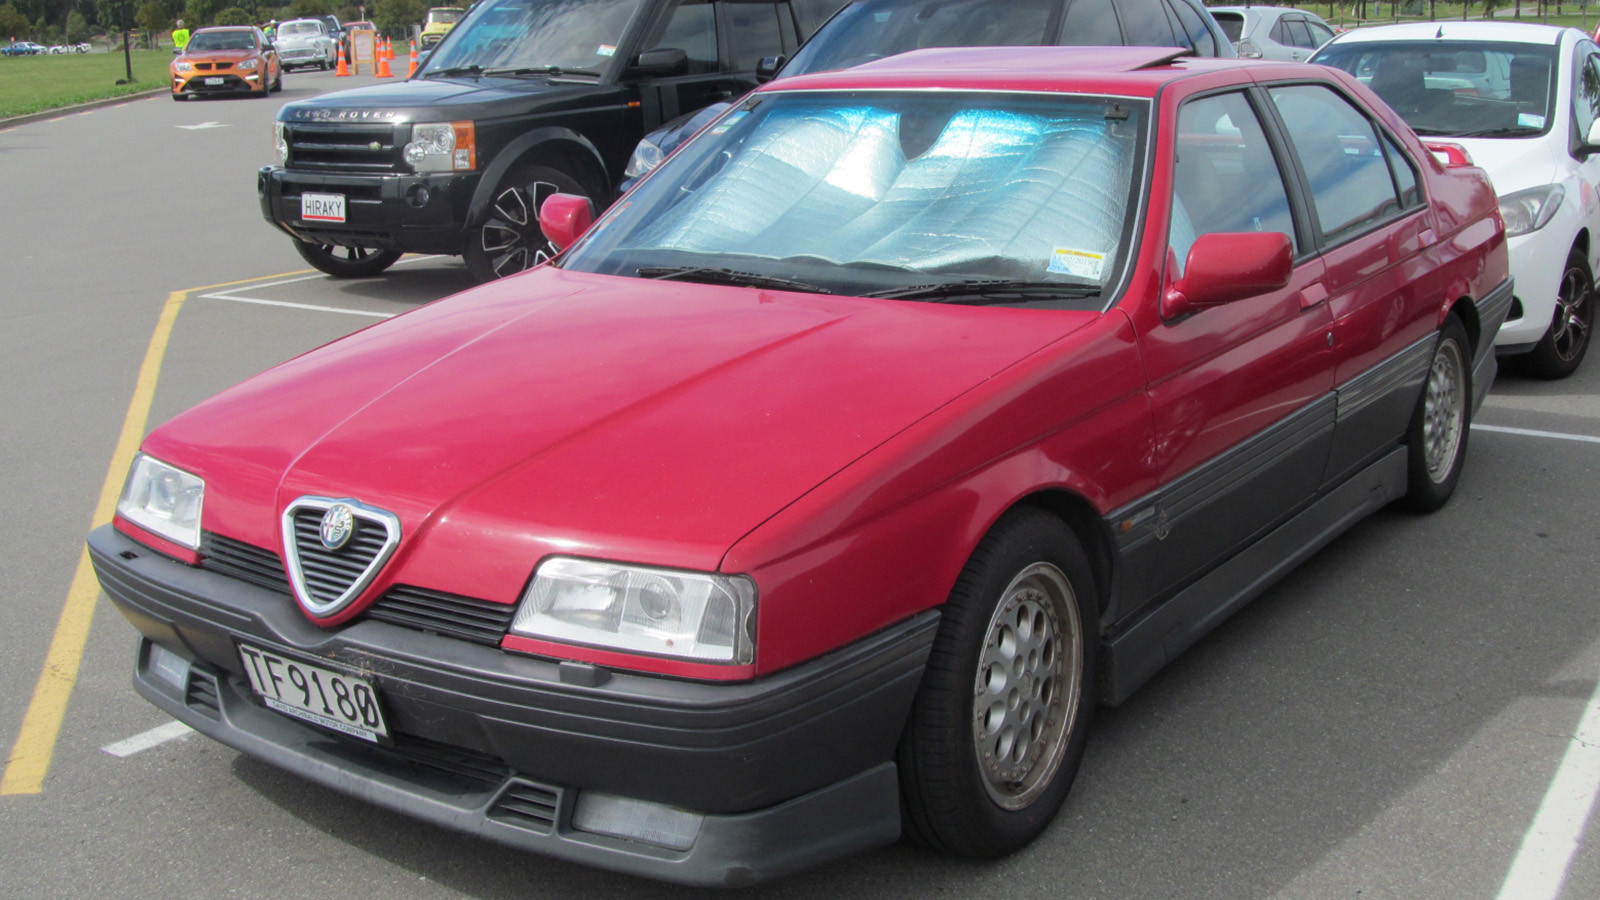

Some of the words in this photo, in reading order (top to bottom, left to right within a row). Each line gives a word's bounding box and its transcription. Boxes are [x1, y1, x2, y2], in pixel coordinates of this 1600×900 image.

[296, 110, 331, 118] LAND
[305, 199, 342, 216] HIRAKY
[241, 646, 380, 728] TF9180
